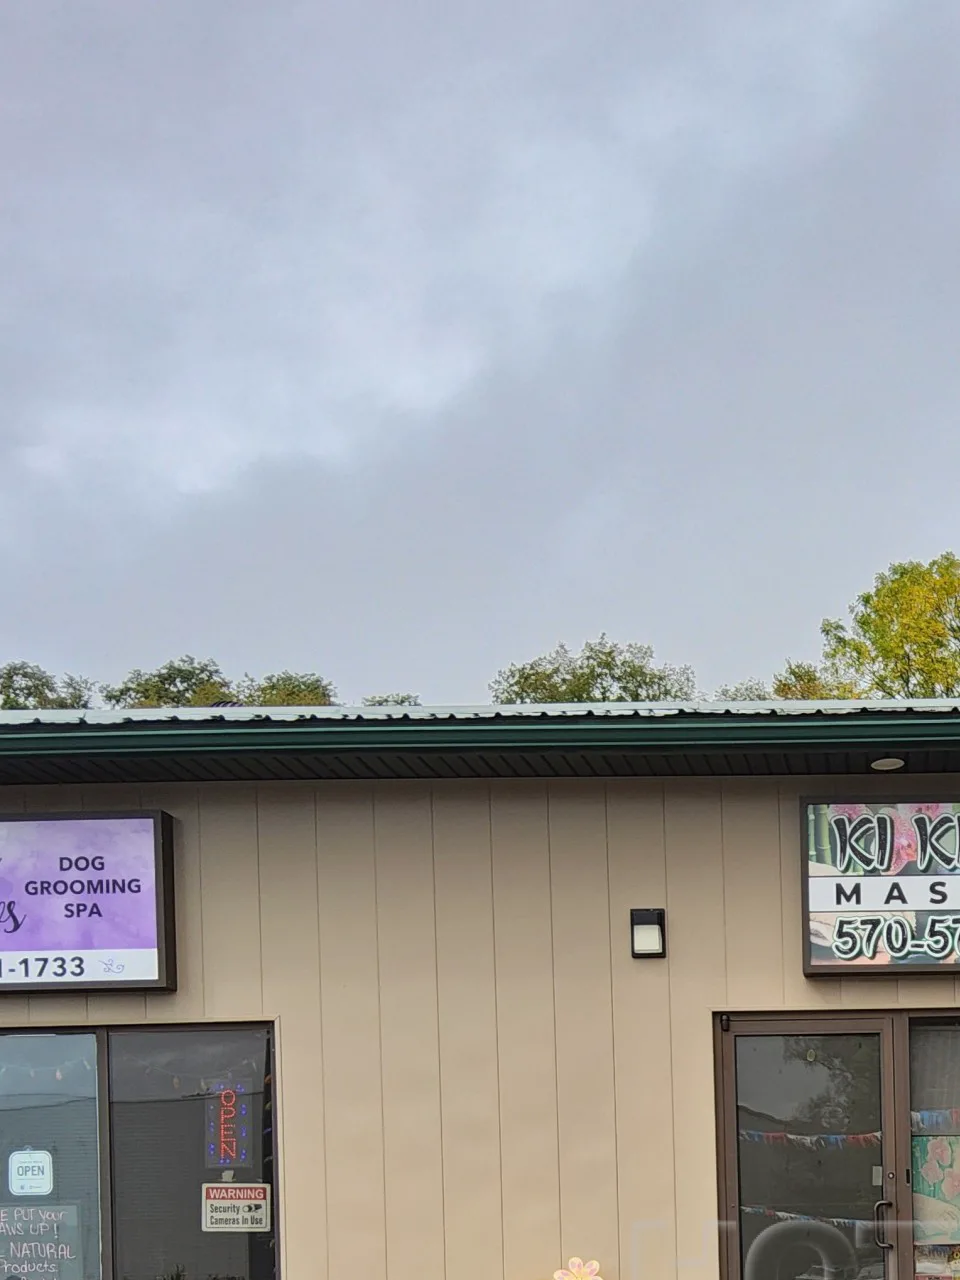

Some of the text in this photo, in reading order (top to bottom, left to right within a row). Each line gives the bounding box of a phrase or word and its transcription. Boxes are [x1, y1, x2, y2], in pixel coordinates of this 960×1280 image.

[832, 813, 893, 872] KI
[59, 856, 105, 871] DOG
[24, 878, 142, 896] GROOMING
[64, 903, 103, 918] SPA
[220, 1089, 236, 1159] OPEN
[16, 1165, 45, 1177] OPEN
[208, 1188, 264, 1199] WARNING
[14, 1207, 36, 1221] PUT
[209, 1203, 241, 1215] Security
[209, 1215, 264, 1226] Cameras In Use
[10, 1242, 77, 1260] NATURAL
